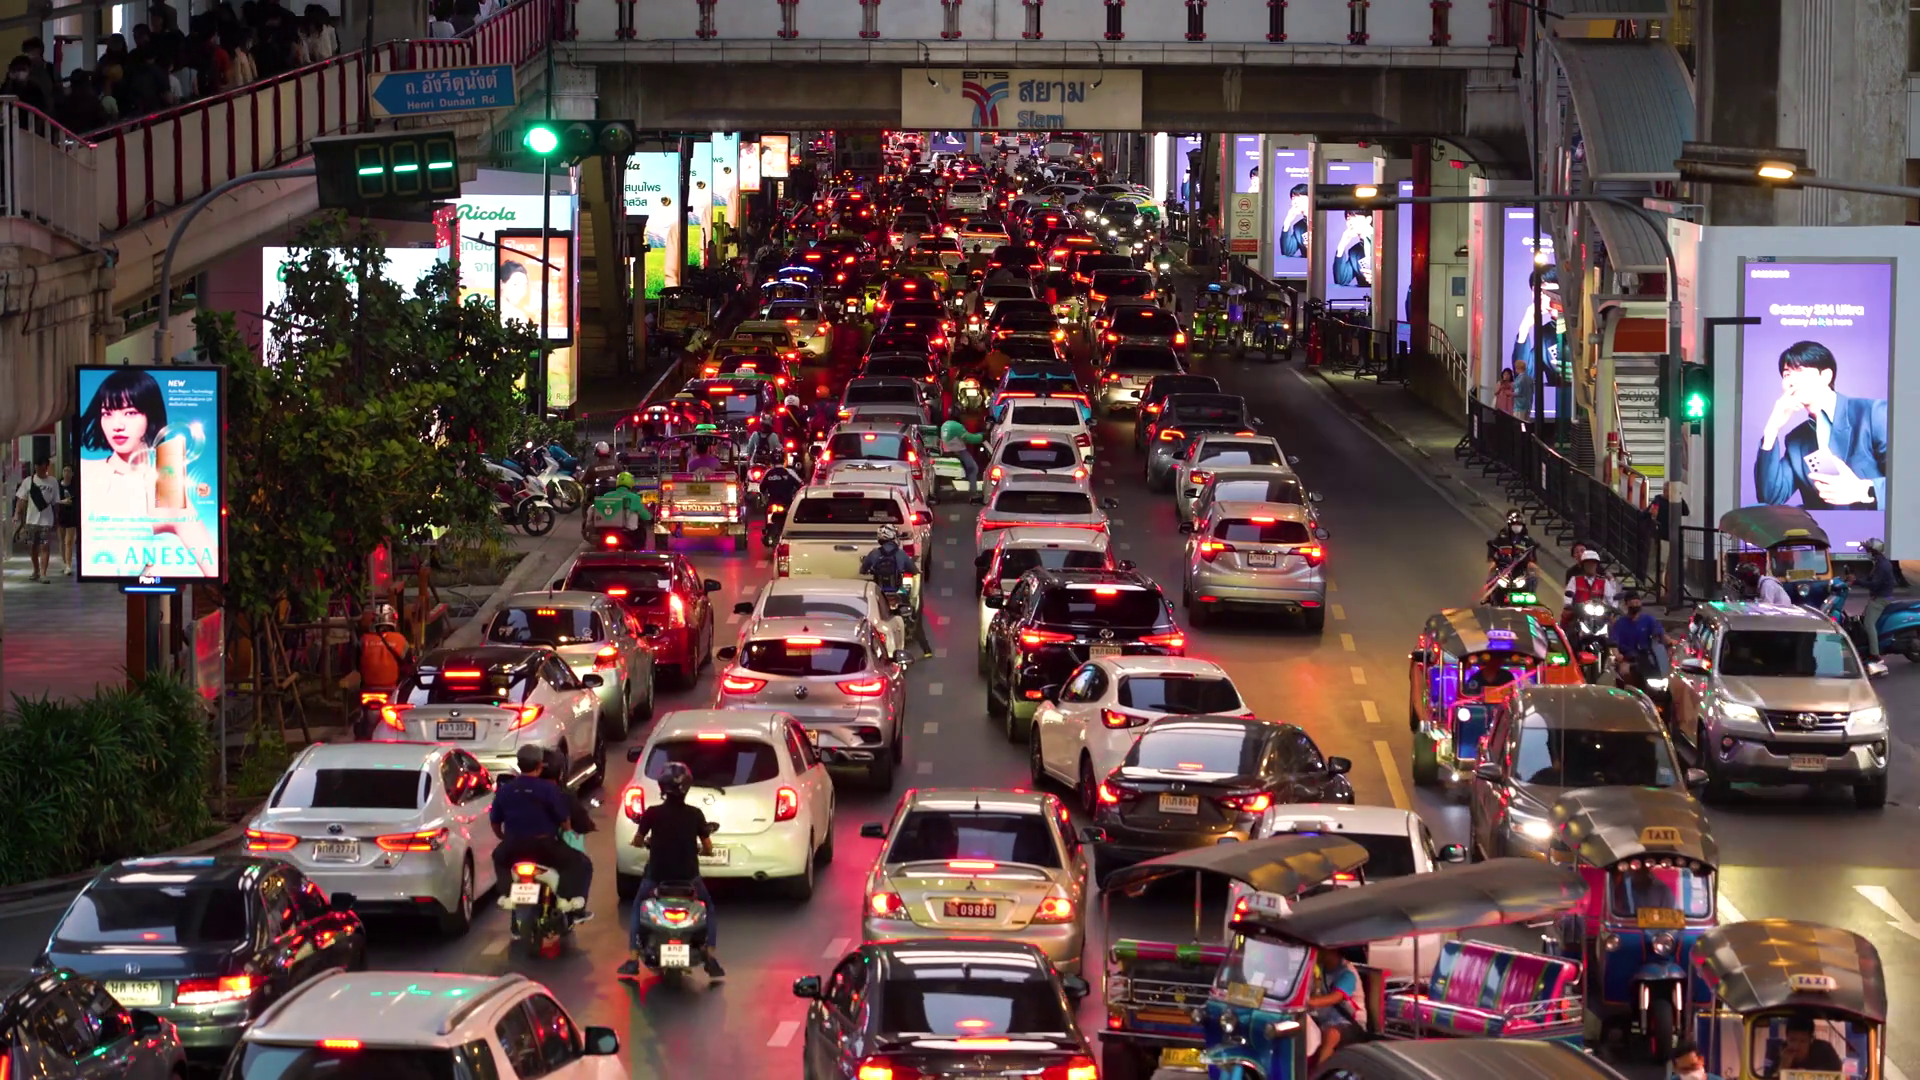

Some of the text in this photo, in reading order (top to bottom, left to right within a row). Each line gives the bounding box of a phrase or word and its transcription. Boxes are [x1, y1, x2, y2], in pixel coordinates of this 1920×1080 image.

[962, 71, 1009, 79] BTS
[1018, 79, 1085, 103] สยาม
[407, 100, 434, 110] Henri
[440, 97, 475, 108] Dunant
[1017, 110, 1065, 128] Siam
[456, 204, 517, 221] Ricola
[168, 379, 186, 387] NEW
[125, 546, 214, 565] ANESSA
[1646, 829, 1676, 840] TAXI
[960, 904, 995, 917] 09889
[1798, 975, 1828, 984] TAXI
